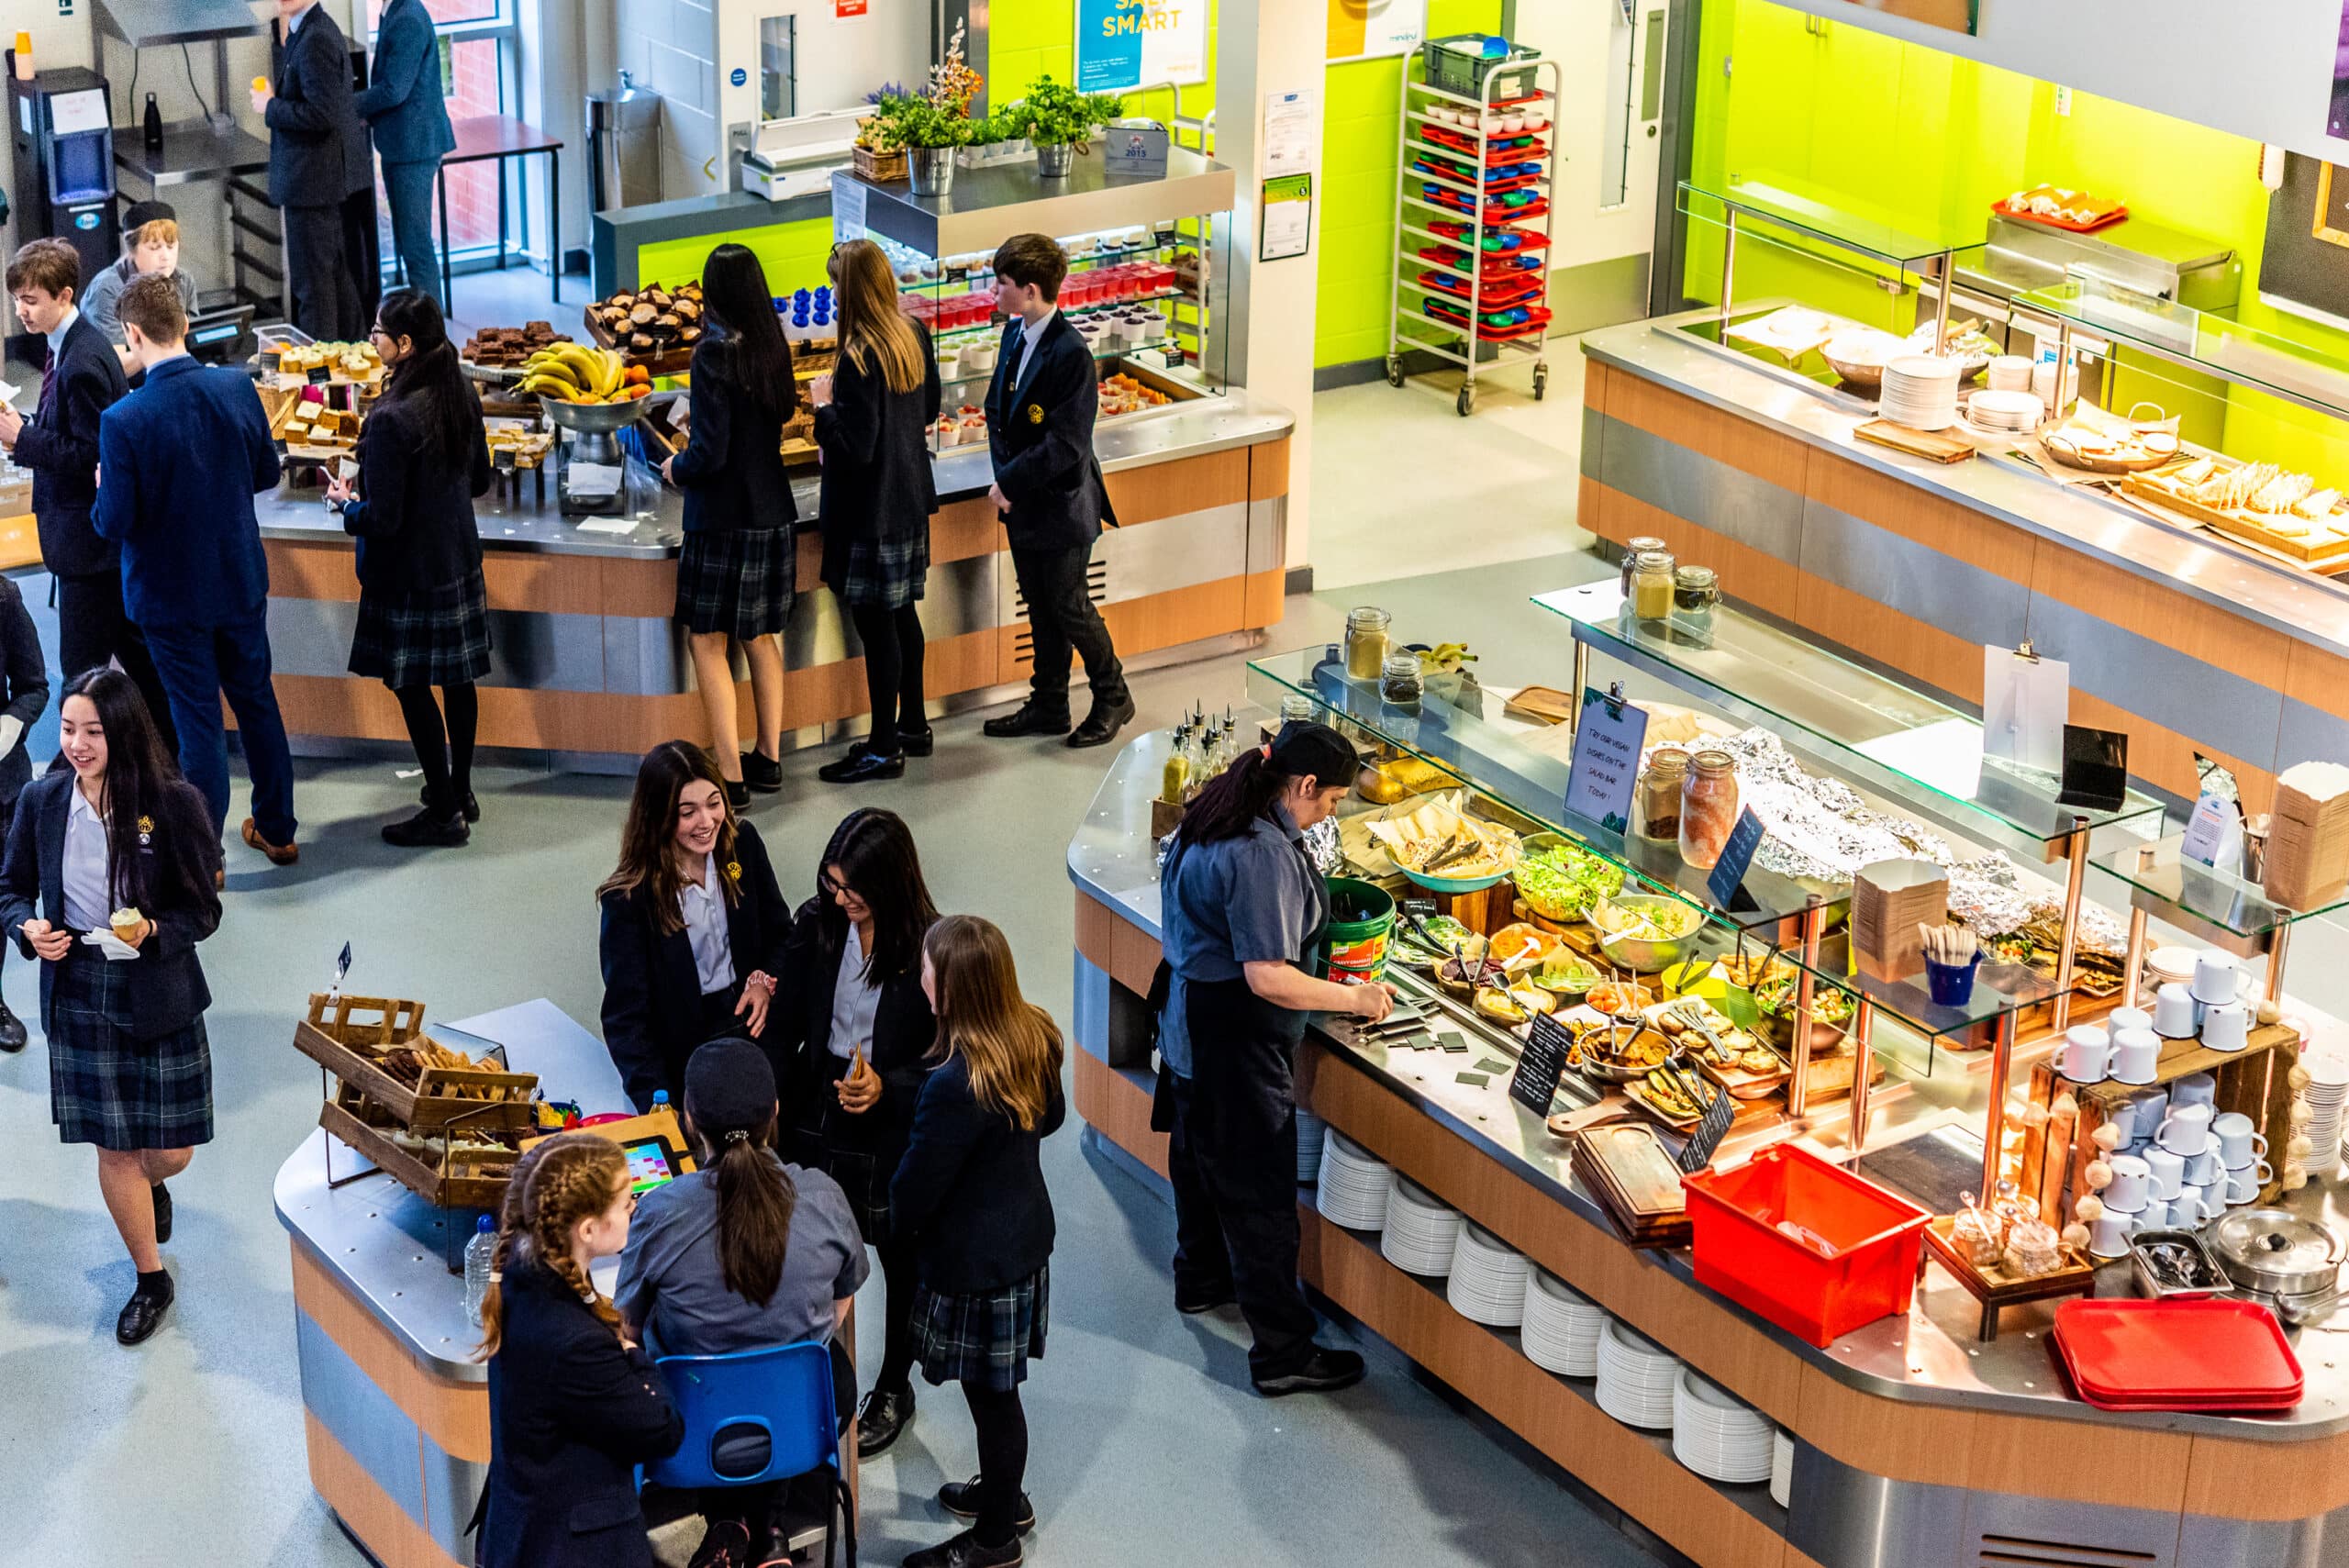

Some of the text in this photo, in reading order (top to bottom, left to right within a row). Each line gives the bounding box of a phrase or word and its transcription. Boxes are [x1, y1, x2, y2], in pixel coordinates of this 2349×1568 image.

[1102, 9, 1182, 37] SMART
[1589, 728, 1630, 751] TRY OUR VEGAN
[1605, 755, 1615, 765] ON
[1615, 759, 1627, 770] THE
[1588, 767, 1617, 785] SALAD BAR
